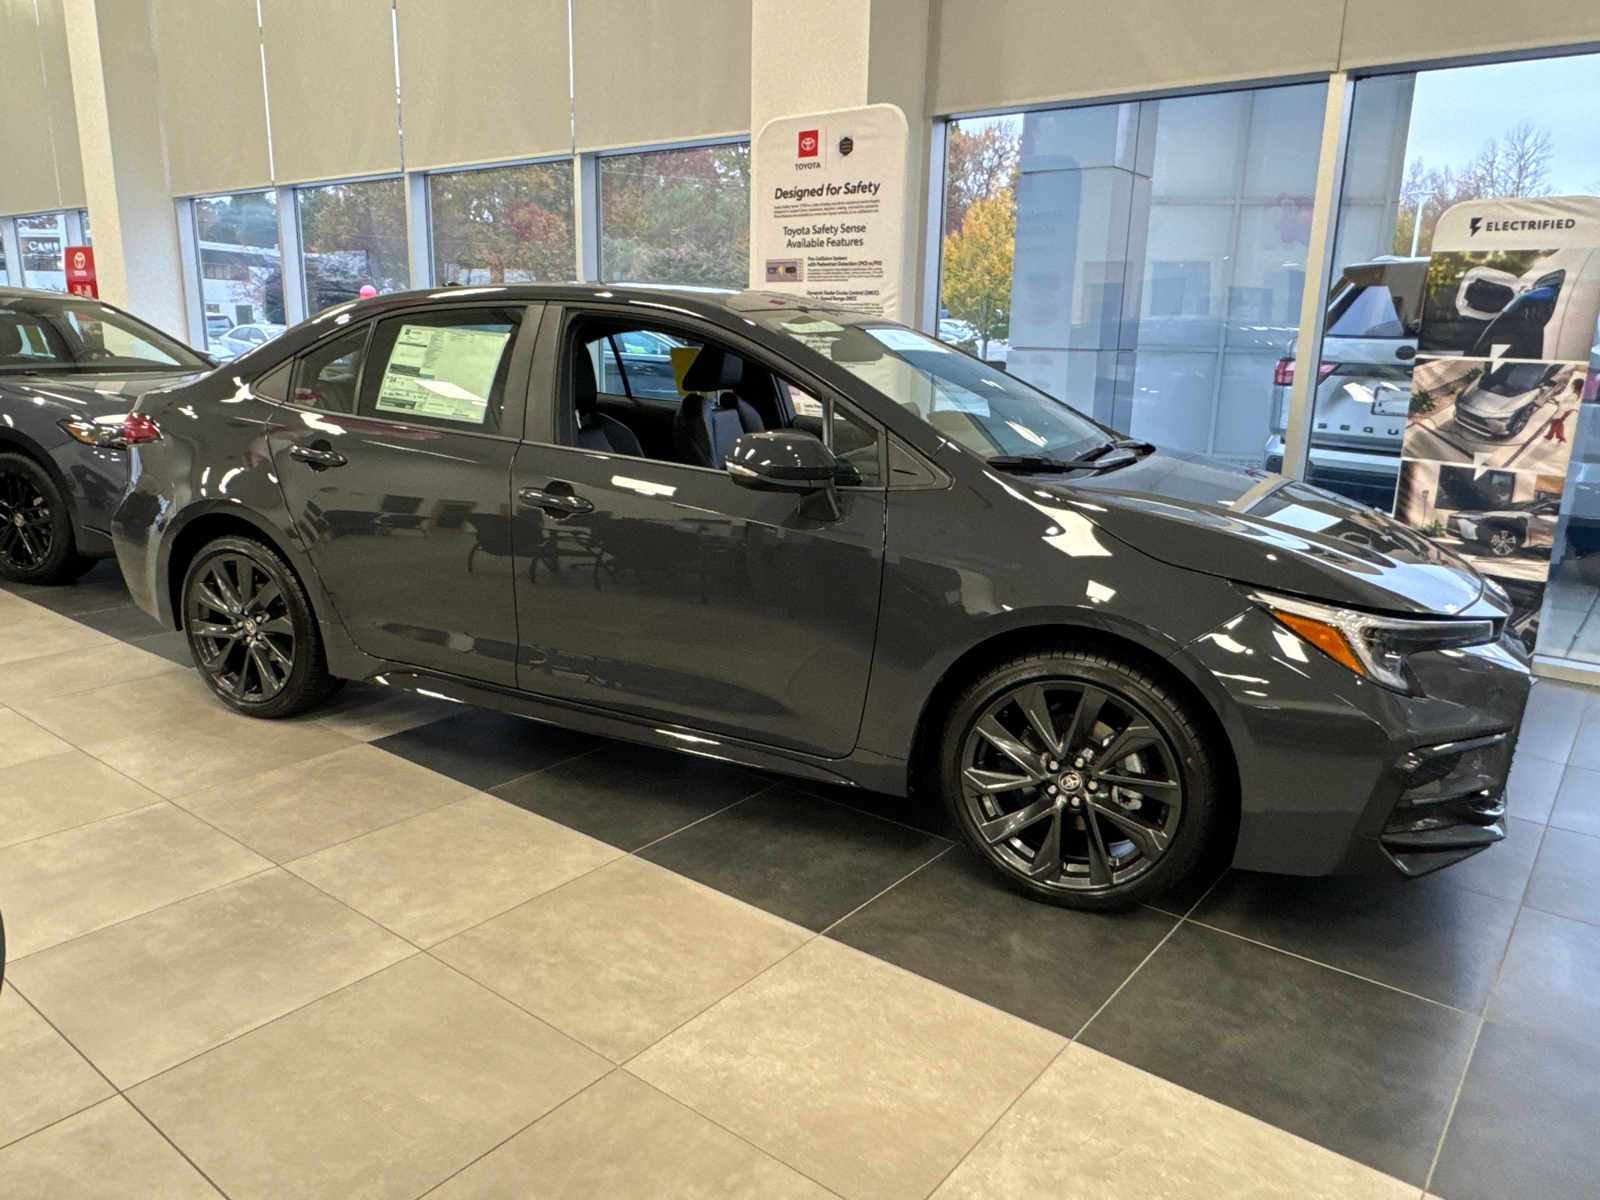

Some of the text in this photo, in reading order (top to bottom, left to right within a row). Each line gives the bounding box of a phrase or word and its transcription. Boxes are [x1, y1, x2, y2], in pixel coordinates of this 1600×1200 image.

[795, 162, 821, 170] TOYOTA
[774, 181, 881, 201] Designed for Safety
[783, 223, 867, 238] Toyota Safety Sense
[1486, 218, 1576, 232] ELECTRIFIED
[786, 237, 864, 248] Available Features
